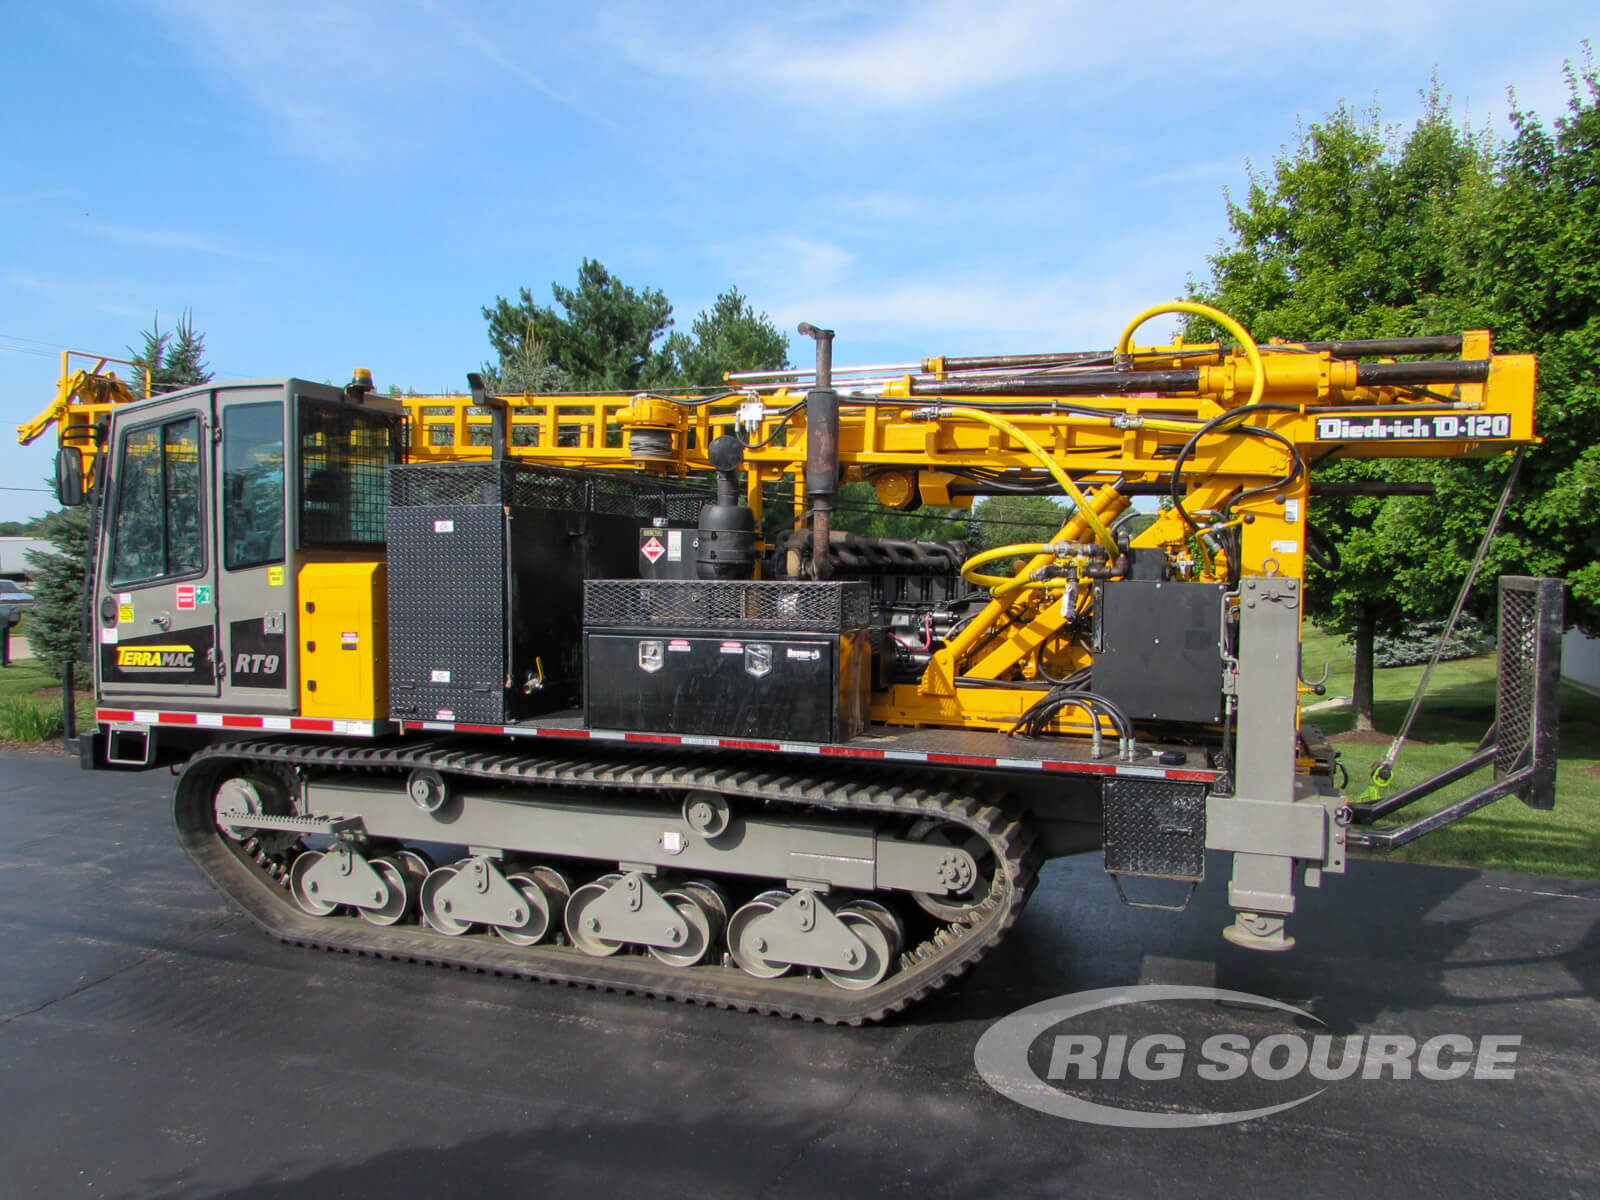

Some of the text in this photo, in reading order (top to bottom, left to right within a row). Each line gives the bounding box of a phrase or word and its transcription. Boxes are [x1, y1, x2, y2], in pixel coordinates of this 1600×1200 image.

[1317, 417, 1429, 439] Diedrich
[116, 644, 195, 667] TERRAMAC
[234, 653, 280, 674] RT9
